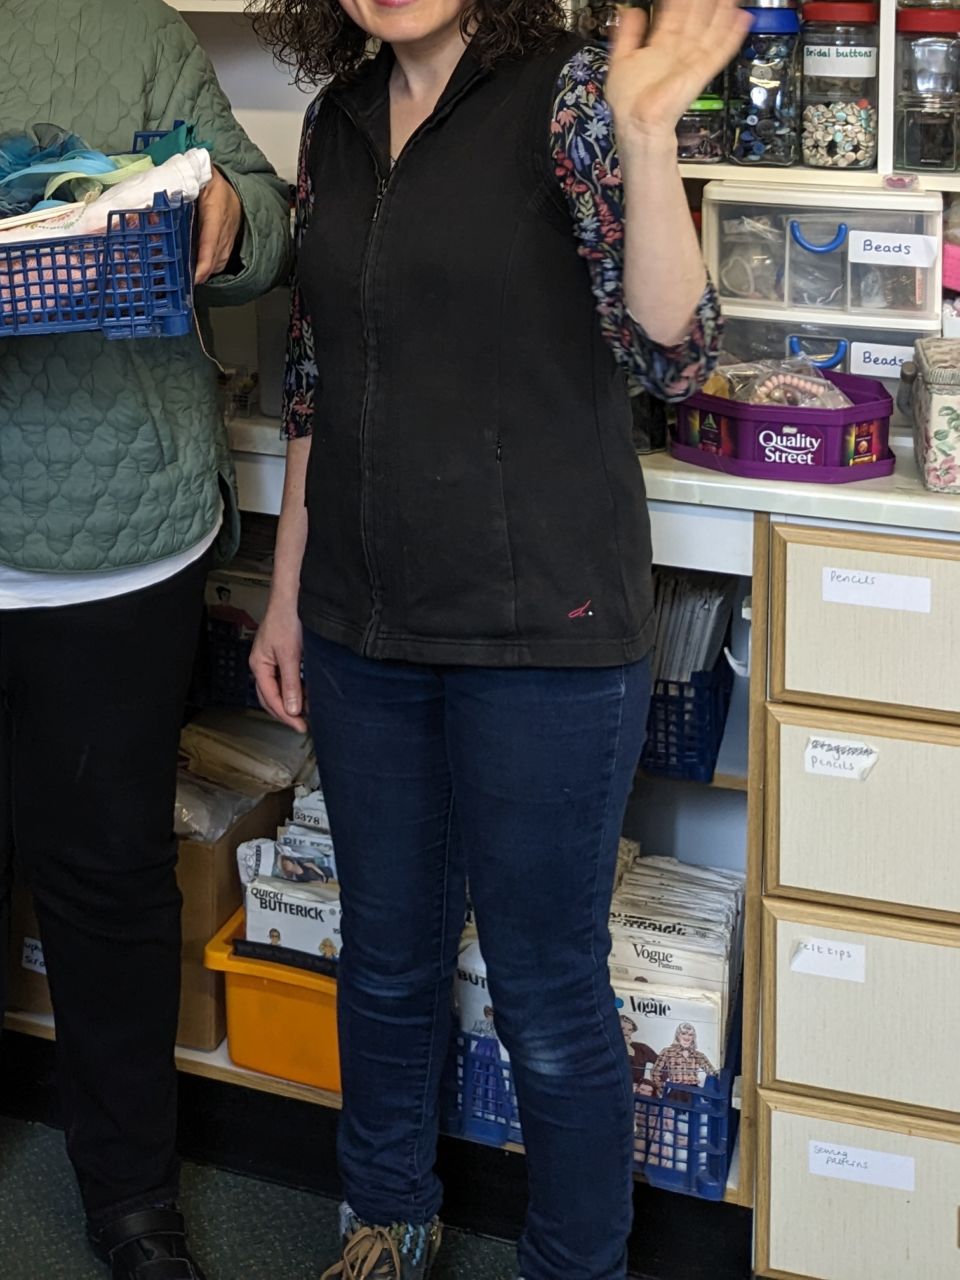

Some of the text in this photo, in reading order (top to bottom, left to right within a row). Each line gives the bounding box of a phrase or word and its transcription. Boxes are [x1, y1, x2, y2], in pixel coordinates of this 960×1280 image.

[805, 47, 873, 59] Bridal buttons
[862, 238, 912, 255] Beads
[758, 429, 822, 452] Quality
[764, 446, 815, 465] Street
[830, 569, 876, 585] Pencils
[294, 811, 321, 826] 5378
[250, 887, 284, 901] QUICK!
[259, 897, 325, 922] BUTTERICK
[631, 942, 673, 964] Vogue
[827, 946, 852, 961] tips
[657, 959, 683, 972] Patterns
[629, 994, 672, 1018] Vogue
